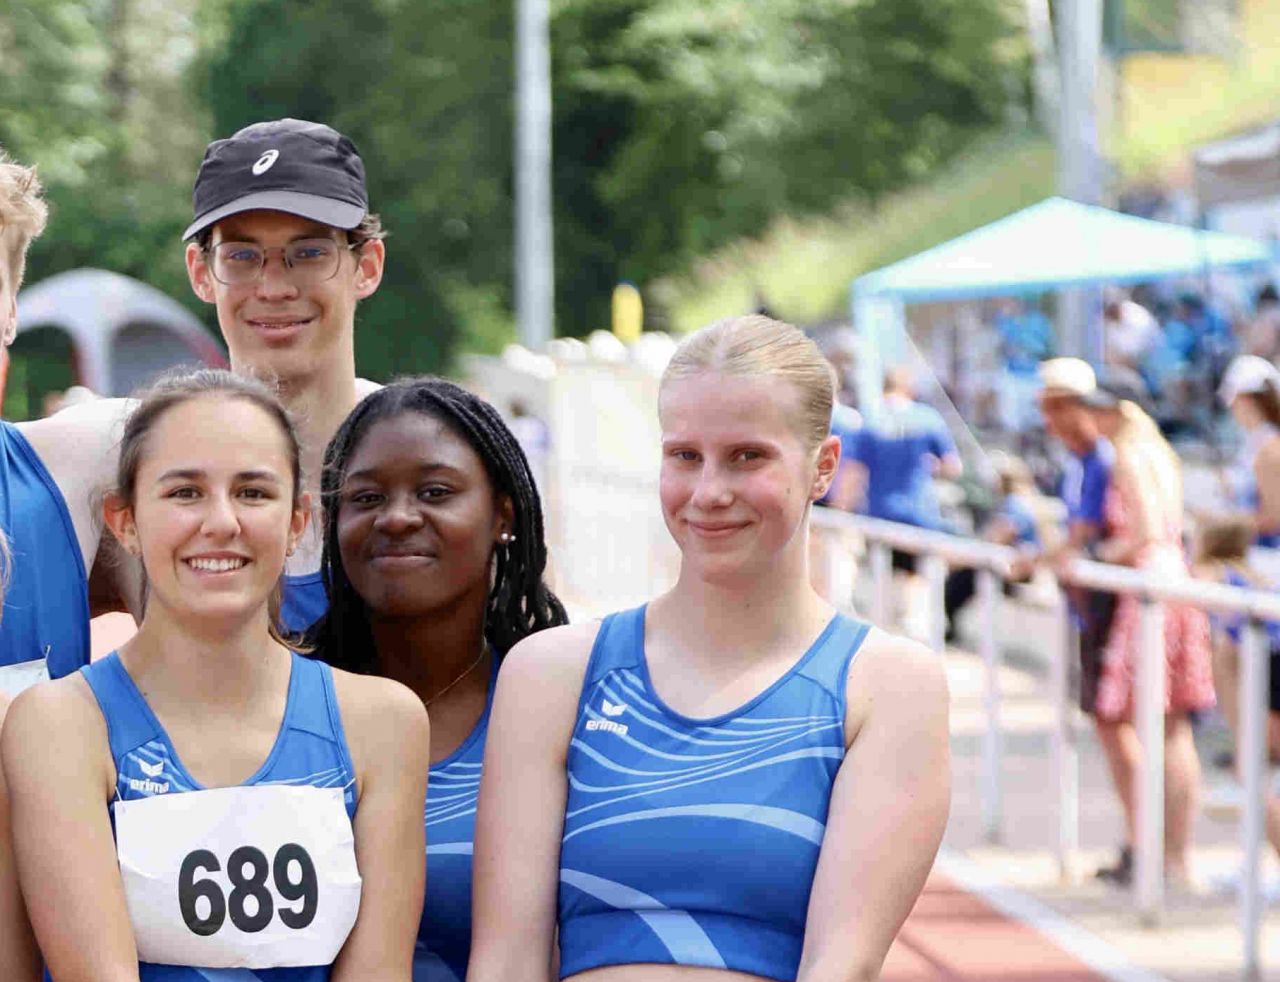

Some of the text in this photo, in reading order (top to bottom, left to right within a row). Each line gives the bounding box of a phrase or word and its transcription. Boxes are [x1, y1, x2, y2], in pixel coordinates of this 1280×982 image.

[585, 719, 629, 736] erima
[130, 778, 170, 794] erima
[178, 843, 319, 937] 689
